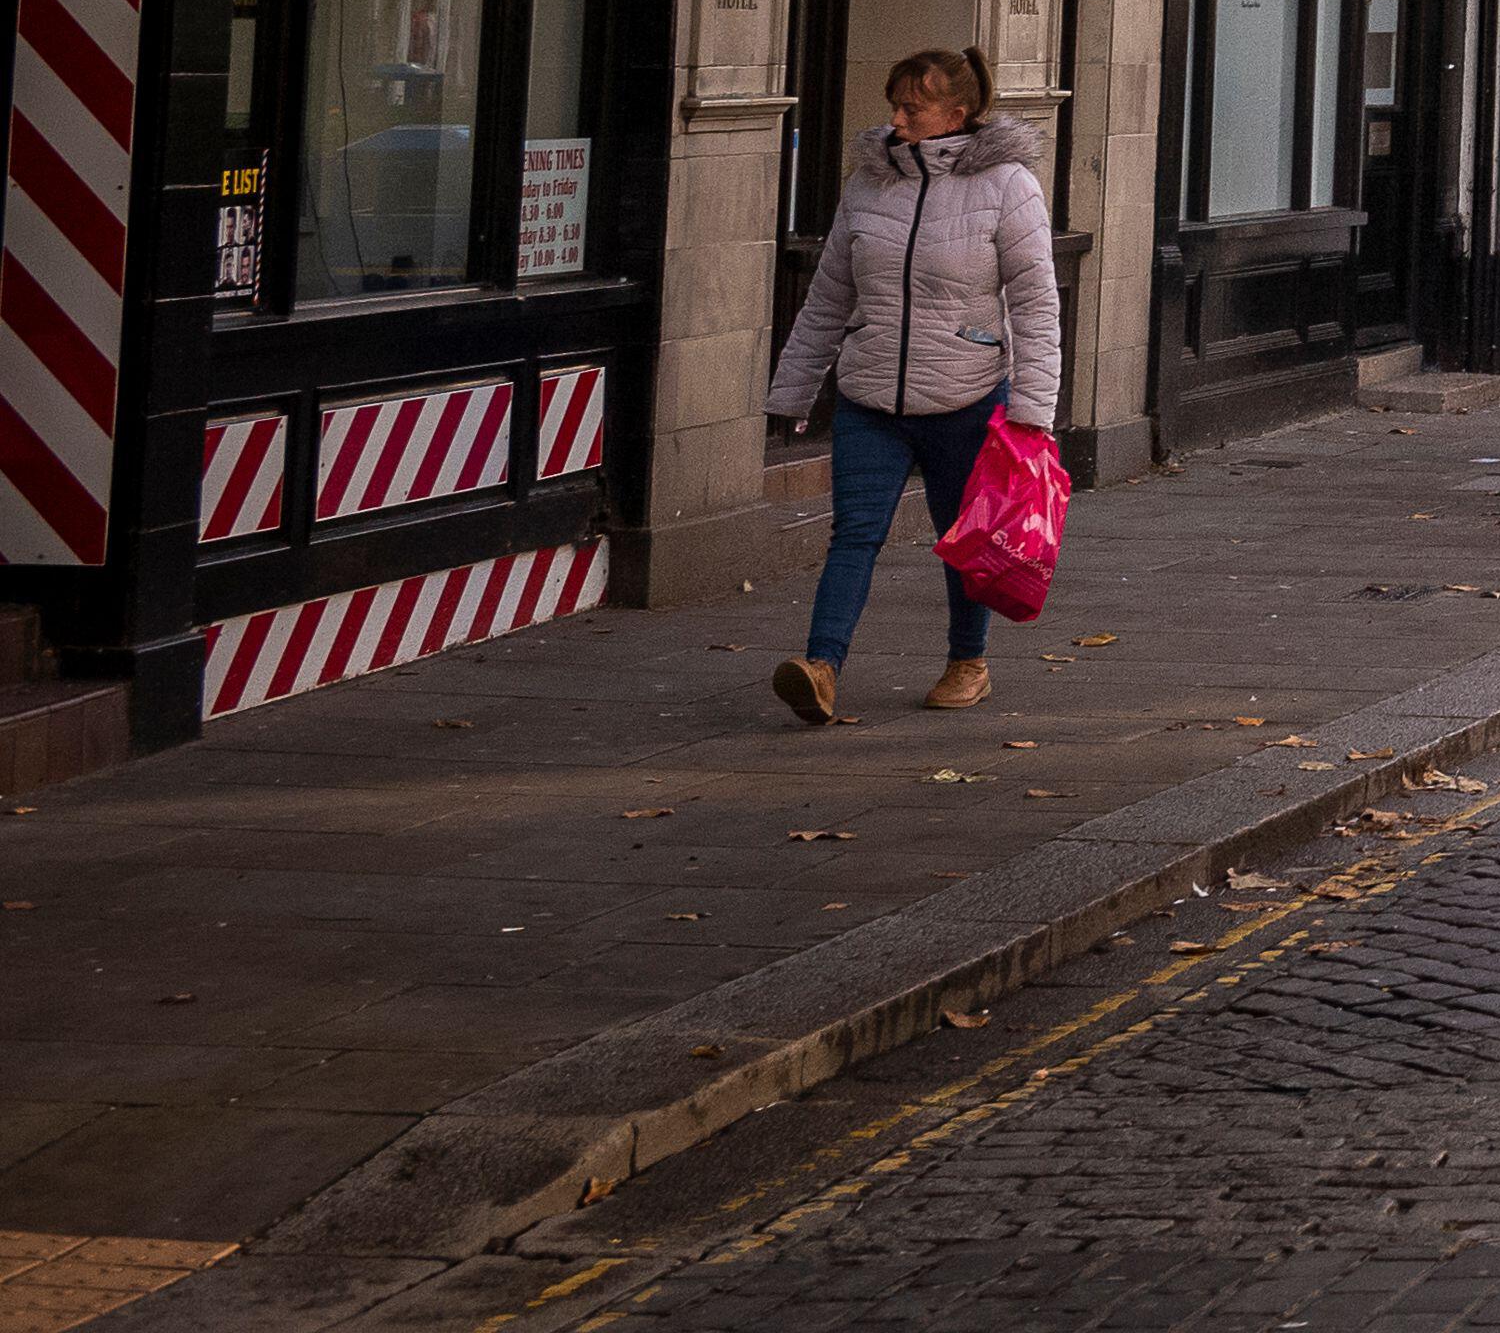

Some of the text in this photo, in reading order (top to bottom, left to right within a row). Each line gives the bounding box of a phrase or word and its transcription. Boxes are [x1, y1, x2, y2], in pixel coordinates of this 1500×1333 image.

[555, 148, 586, 171] TIMES
[221, 168, 260, 196] E LIST
[543, 181, 552, 196] to
[552, 177, 578, 199] Friday
[546, 202, 564, 220] 6.00
[539, 225, 556, 244] 8.30
[563, 223, 580, 241] 6.30
[533, 249, 555, 268] 10.00
[561, 246, 579, 264] 4.00
